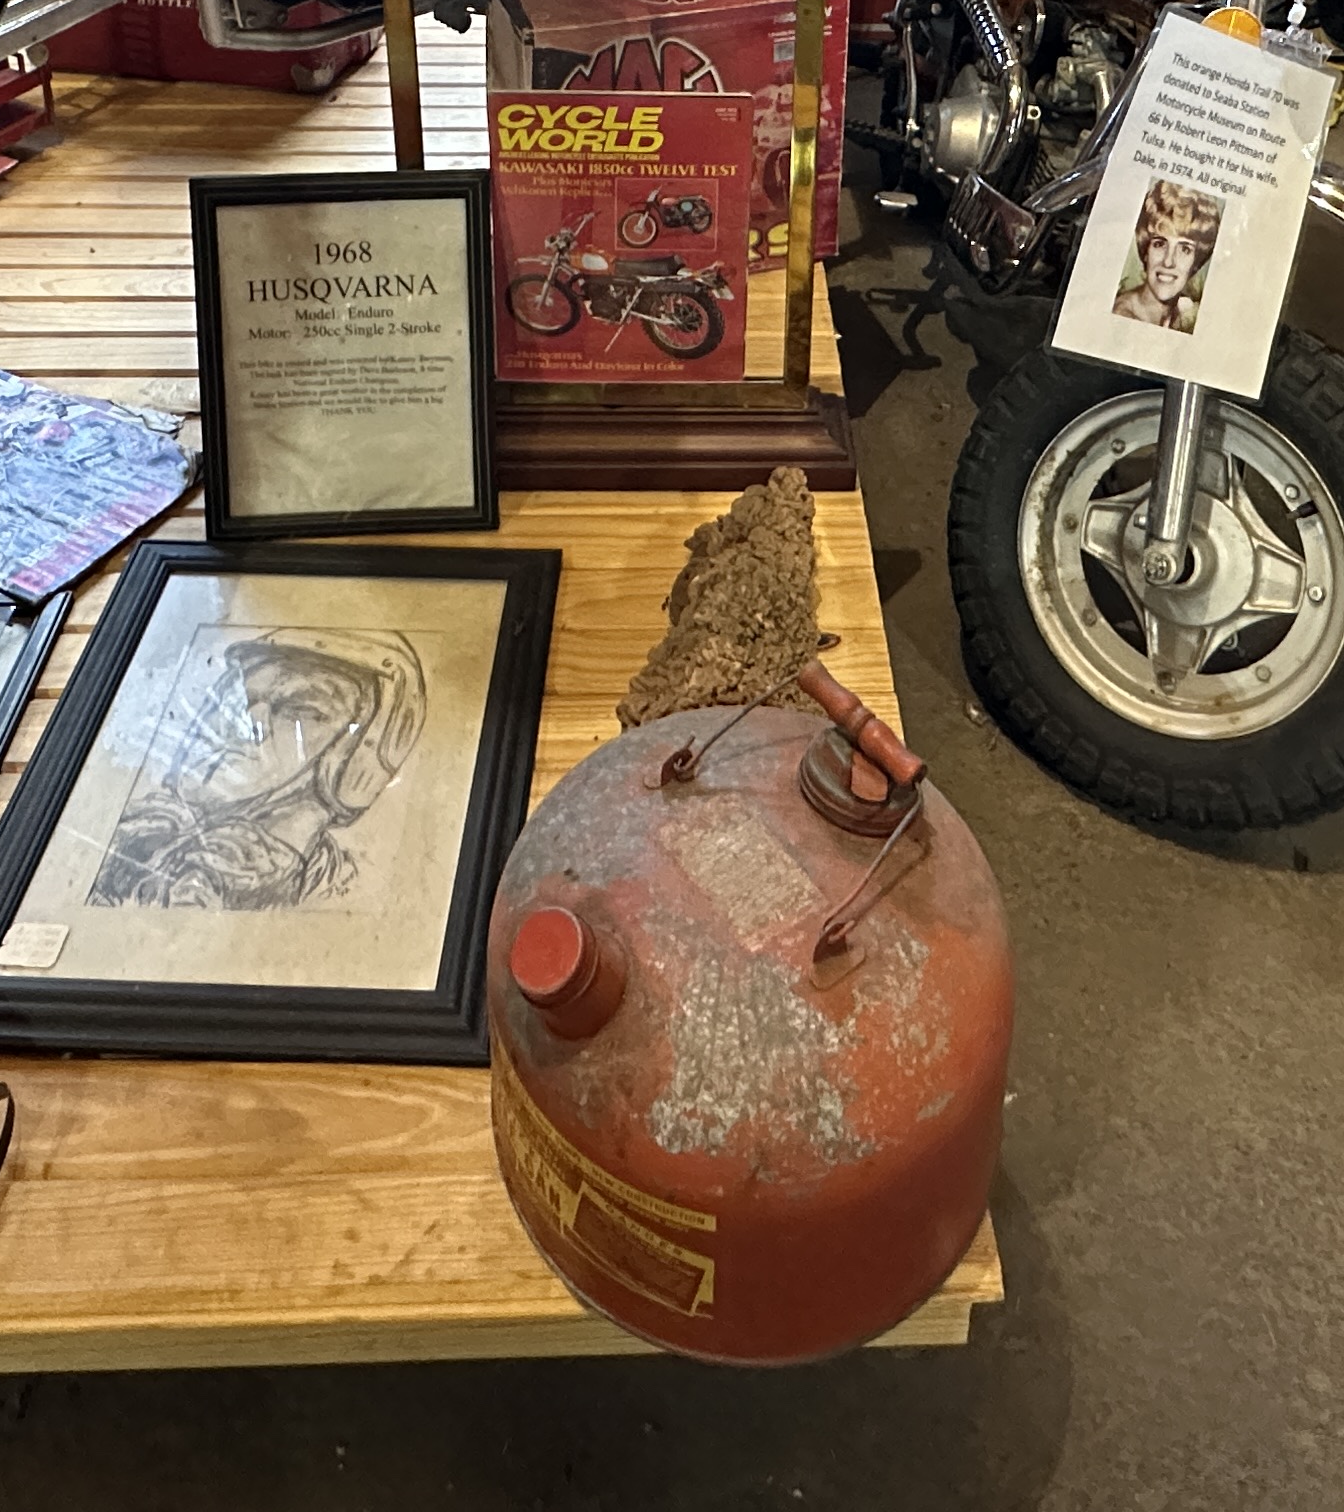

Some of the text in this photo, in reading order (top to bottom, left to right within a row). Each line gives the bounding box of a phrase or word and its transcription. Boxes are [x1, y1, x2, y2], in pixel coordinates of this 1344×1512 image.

[1173, 52, 1300, 111] This orange Honda Trail 70 was
[1163, 73, 1270, 120] donated to Seaba Station
[497, 104, 663, 131] CYCLE
[1156, 91, 1287, 147] Motorcycle Museum on Route
[498, 128, 664, 153] WORLD
[1147, 111, 1278, 164] 66 by Robert Leon Pittman of
[499, 163, 739, 176] KAWASAKI 1850cc TWELVE TEST
[1158, 158, 1168, 172] in
[1197, 172, 1210, 185] All
[1168, 140, 1182, 155] He
[1183, 144, 1215, 166] bought
[1217, 157, 1227, 168] it
[1226, 157, 1240, 173] for
[1240, 163, 1254, 179] his
[1255, 170, 1279, 188] wife,
[313, 240, 373, 265] 1968
[246, 273, 439, 303] HUSQVARNA
[348, 306, 394, 320] Enduro
[303, 324, 342, 339] 250cc
[344, 321, 384, 340] Single
[387, 321, 442, 336] 2-Stroke
